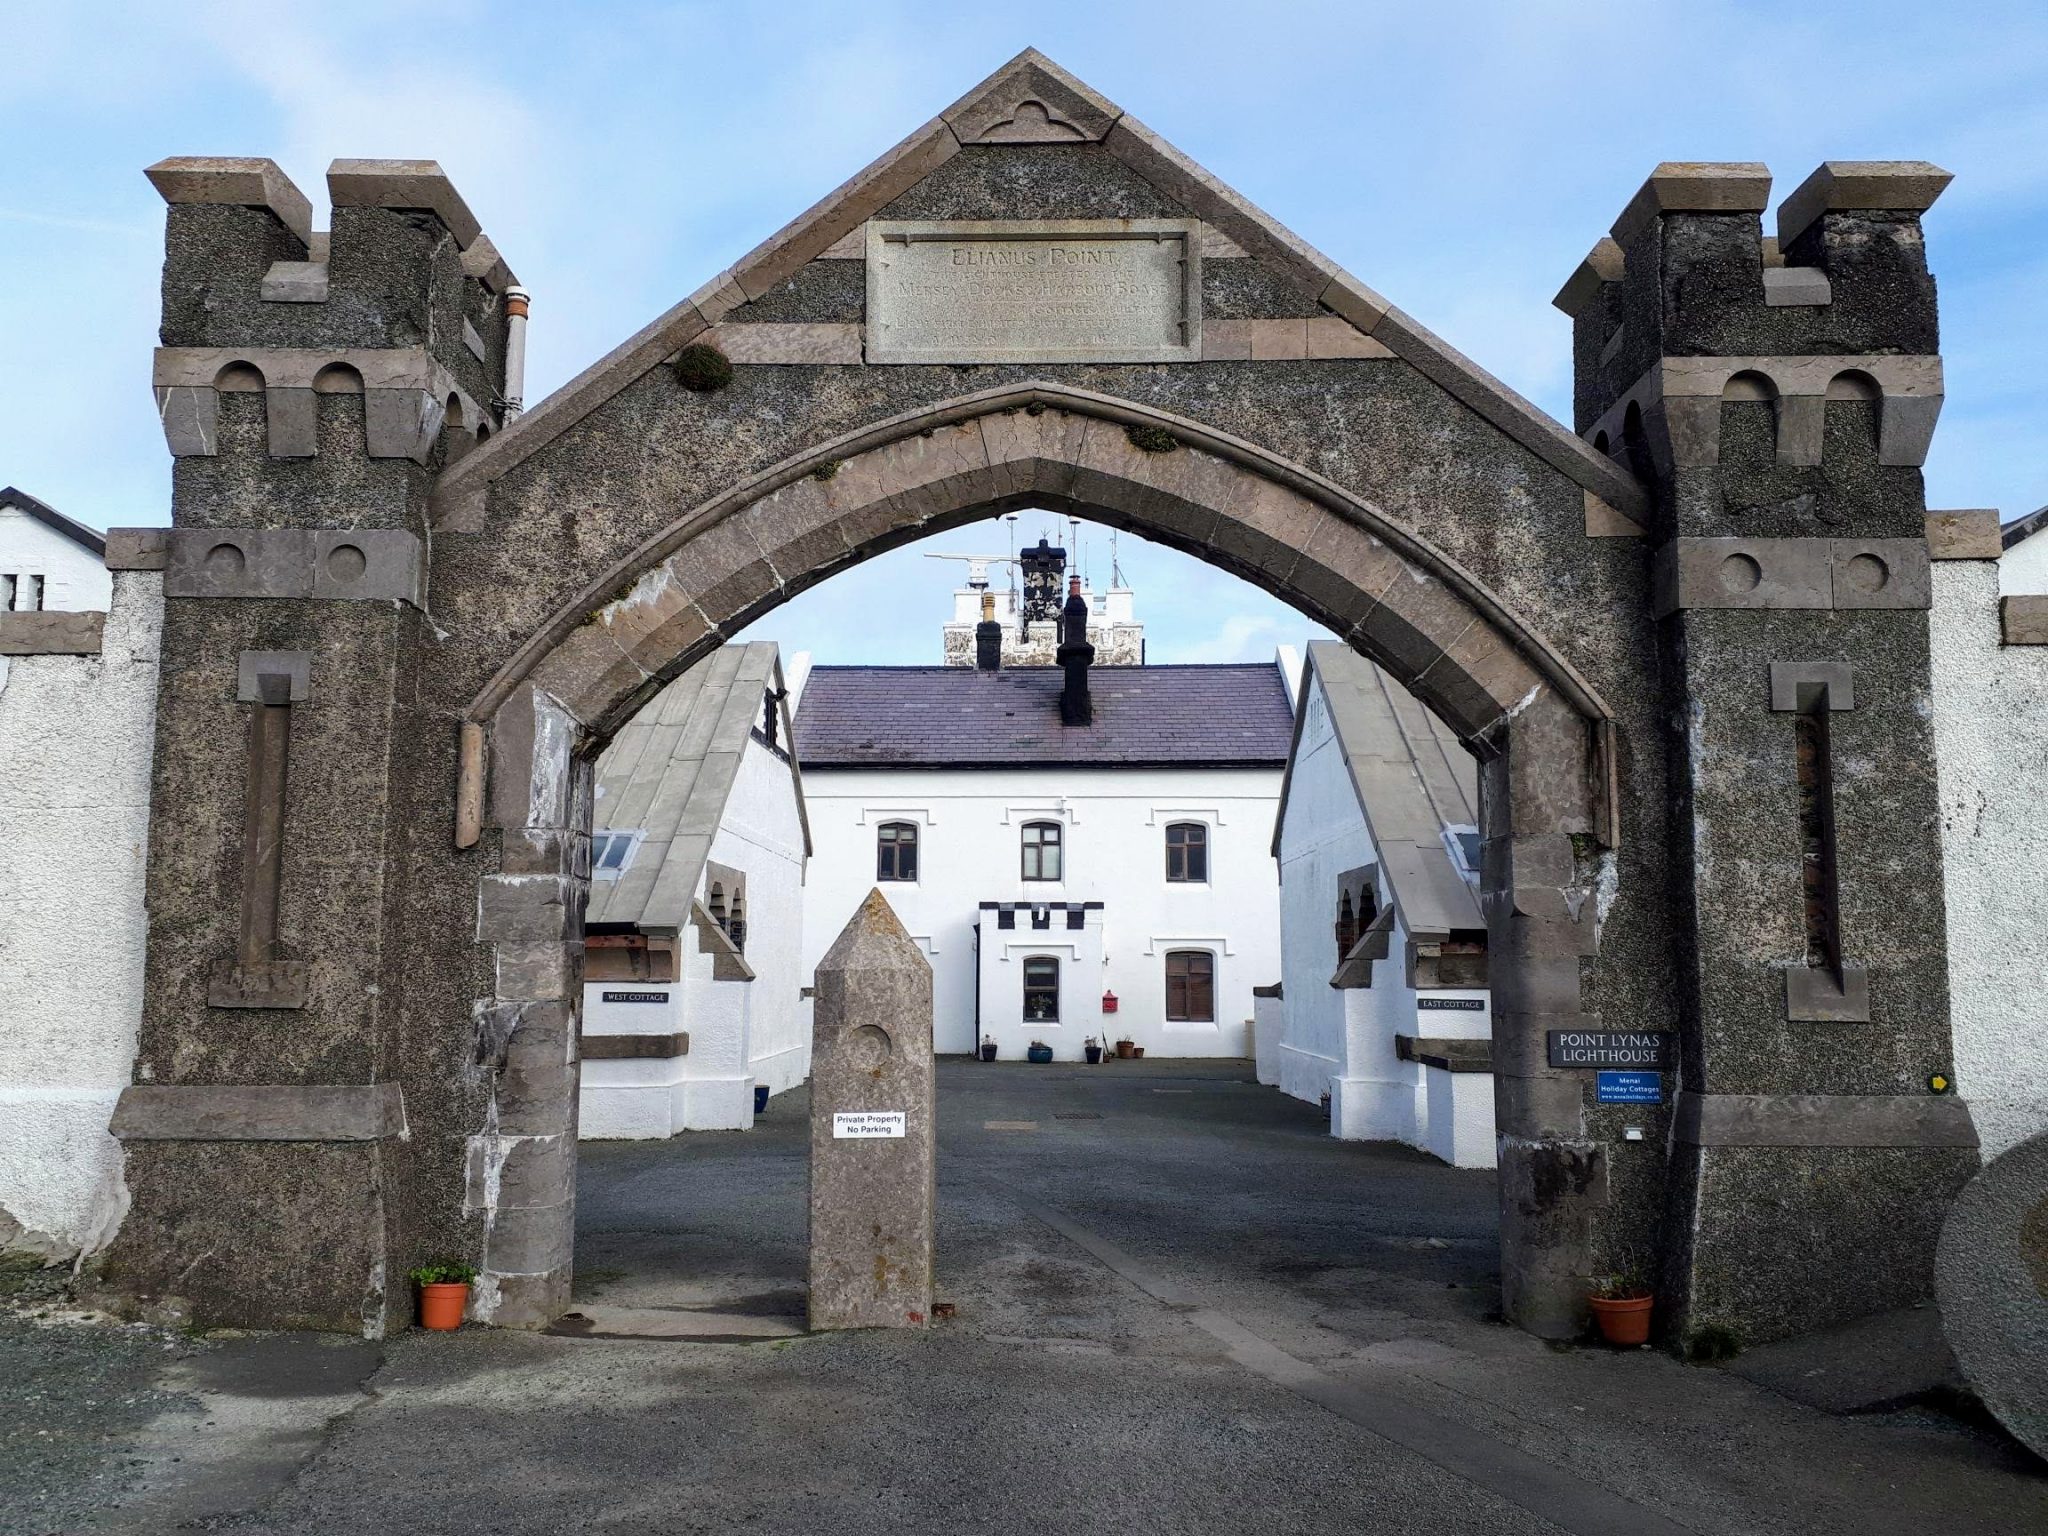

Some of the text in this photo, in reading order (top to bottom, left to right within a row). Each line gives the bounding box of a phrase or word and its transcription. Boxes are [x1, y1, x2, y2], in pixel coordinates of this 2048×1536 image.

[953, 248, 1036, 266] ELIANUS
[607, 993, 665, 1002] WEST COTTAGE
[1423, 1000, 1480, 1009] EAST COTTAGE
[1560, 1033, 1660, 1048] POINT LYNAS
[1562, 1049, 1659, 1062] LIGHTHOUSE
[1619, 1077, 1641, 1085] Menai
[1601, 1085, 1660, 1095] Holiday Cottages
[837, 1115, 902, 1125] Private Property
[847, 1125, 892, 1135] No Parking
